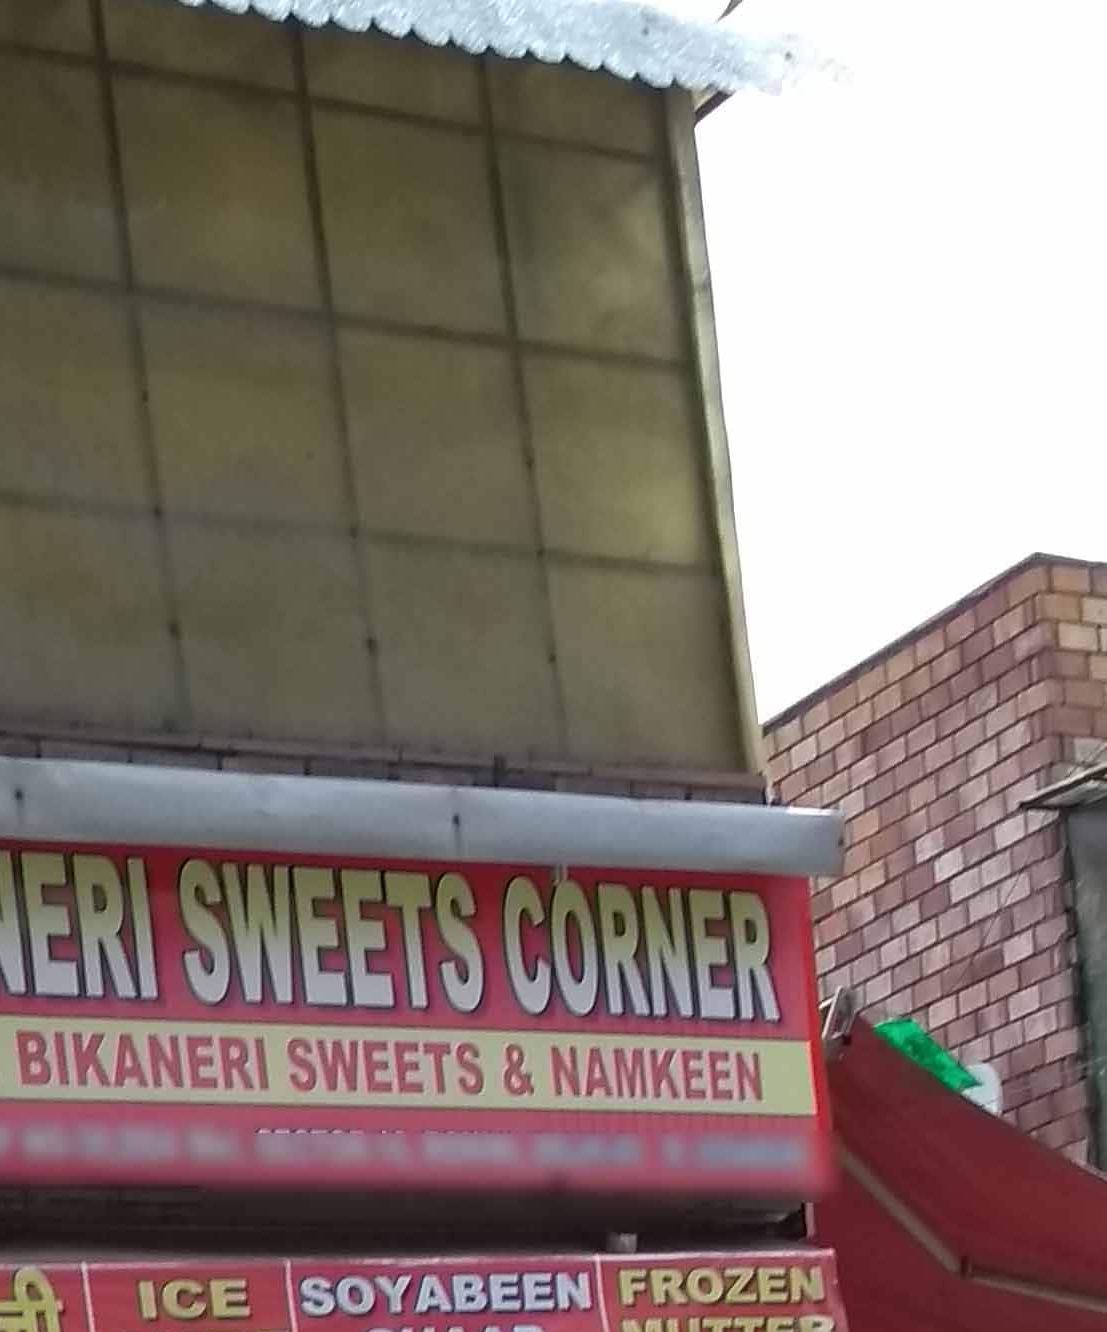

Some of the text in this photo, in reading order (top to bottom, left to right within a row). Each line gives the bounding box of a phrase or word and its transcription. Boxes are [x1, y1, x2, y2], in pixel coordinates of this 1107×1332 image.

[178, 857, 485, 1012] SWEETS
[502, 874, 781, 1022] CORNER
[15, 1030, 269, 1090] BIKANERI
[288, 1036, 485, 1096] SWEETS
[503, 1044, 534, 1097] &
[550, 1046, 763, 1100] NAMKEEN
[137, 1278, 253, 1321] ICE
[299, 1272, 593, 1317] SOYABEEN
[618, 1266, 826, 1306] FROZEN
